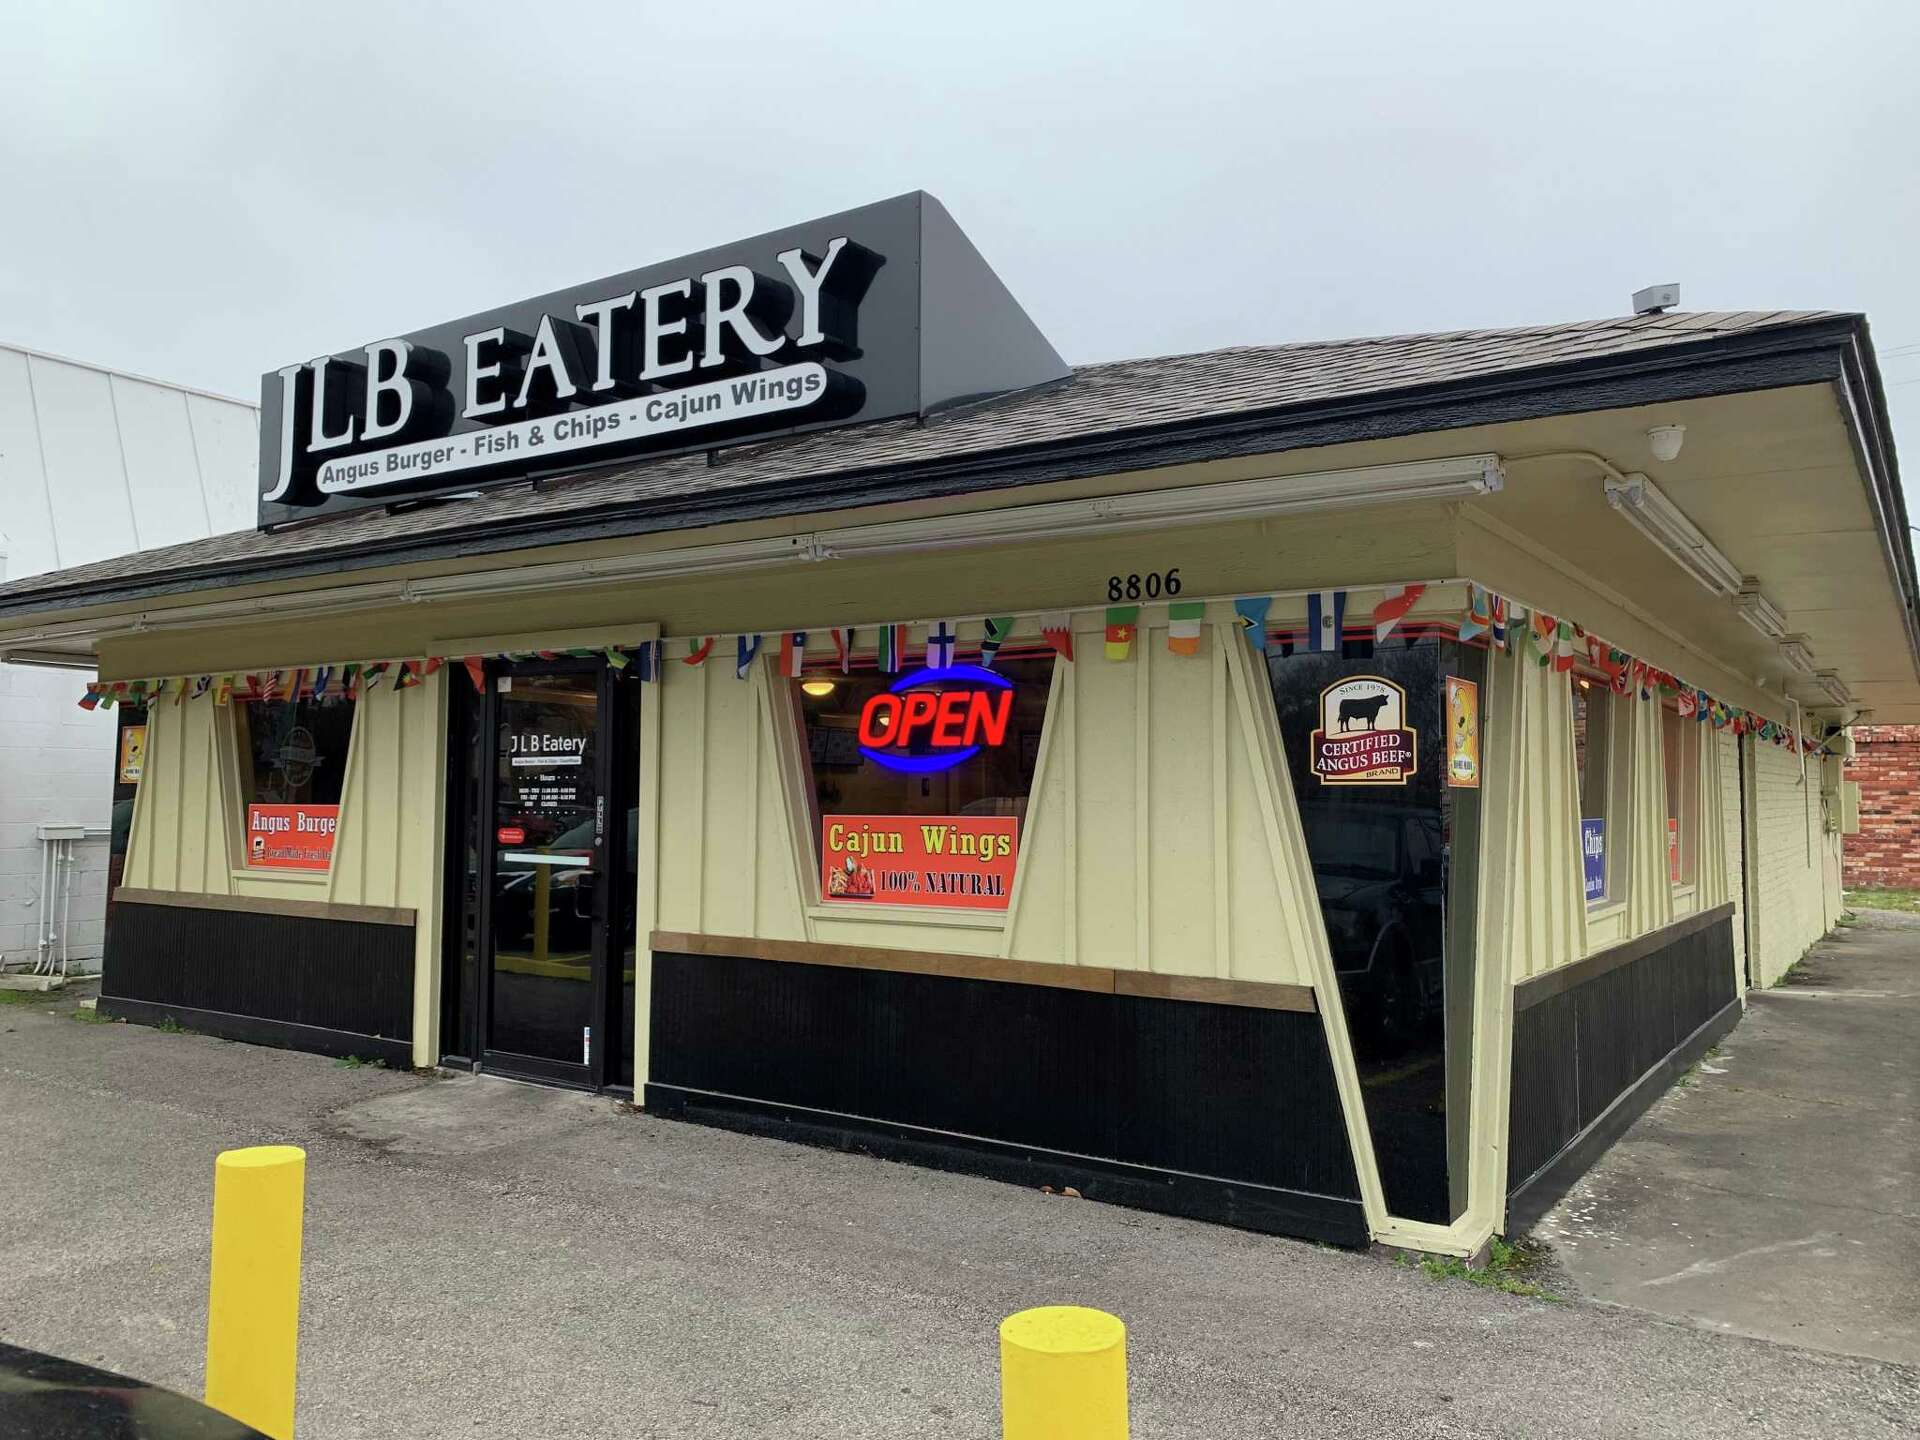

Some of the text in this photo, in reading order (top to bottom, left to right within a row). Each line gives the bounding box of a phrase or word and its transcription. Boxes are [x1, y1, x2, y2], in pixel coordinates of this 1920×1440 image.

[263, 237, 848, 502] JLB EATERY
[322, 460, 379, 484] Angus
[386, 445, 454, 473] Burger
[474, 431, 519, 456] Fish
[528, 425, 544, 446] &
[554, 412, 620, 441] Chips
[645, 392, 721, 422] Cajun
[731, 373, 820, 405] Wings
[1108, 568, 1181, 601] 8806
[858, 690, 1013, 747] OPEN
[511, 734, 587, 755] J L B Eatery
[1322, 734, 1400, 757] CERTIFIED
[1316, 754, 1368, 771] ANGUS
[1366, 768, 1398, 778] BRAND
[252, 811, 337, 836] Angus Burge
[829, 823, 1011, 862] Cajun Wings
[1584, 826, 1603, 862] Chips
[880, 869, 1005, 896] 100% NATURAL
